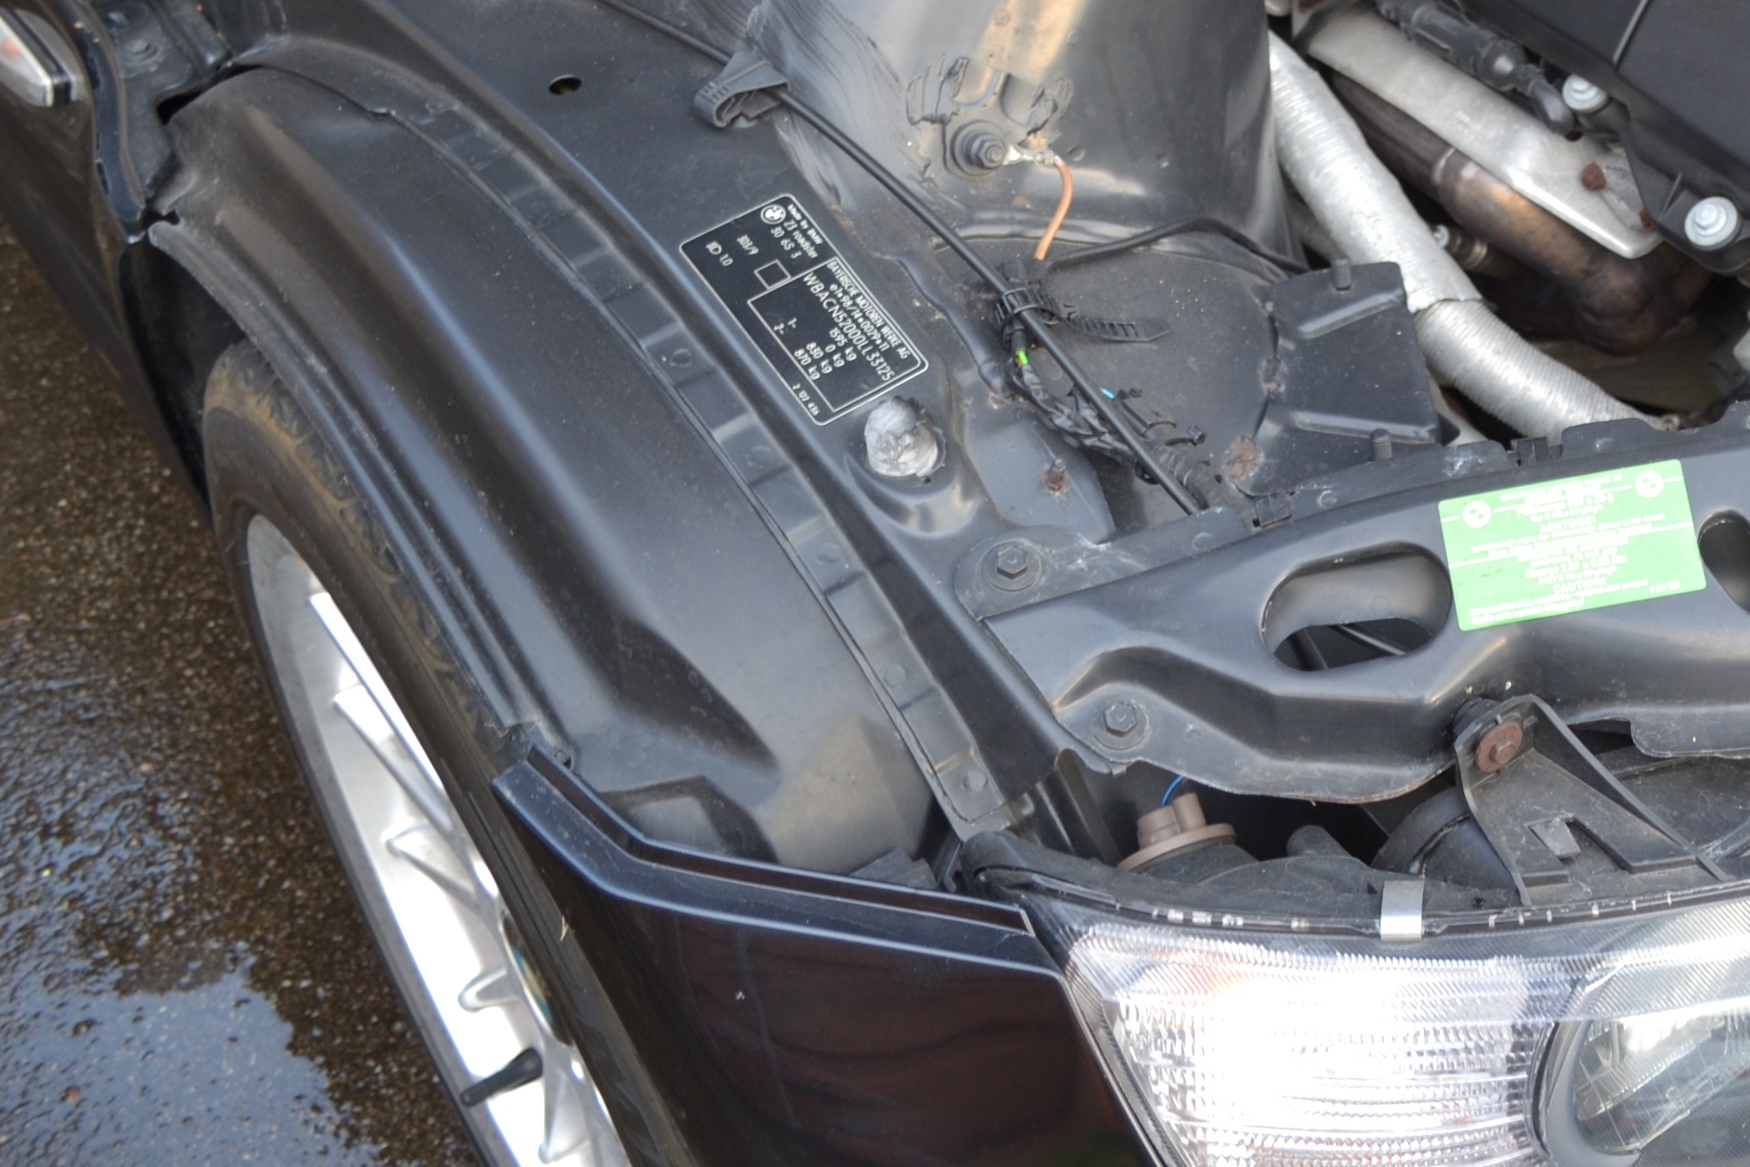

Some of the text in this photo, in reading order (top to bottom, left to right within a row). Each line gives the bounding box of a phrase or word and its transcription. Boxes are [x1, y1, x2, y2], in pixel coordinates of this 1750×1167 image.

[789, 250, 802, 259] 3
[825, 260, 911, 359] BAYERISCHE MOTOREN WERKE AG
[800, 271, 896, 383] WBACN52000LL33125
[824, 343, 848, 368] 0 kg
[841, 346, 860, 362] kg
[805, 365, 824, 381] kg
[817, 358, 836, 375] kg
[1552, 576, 1607, 595] CAUTION!
